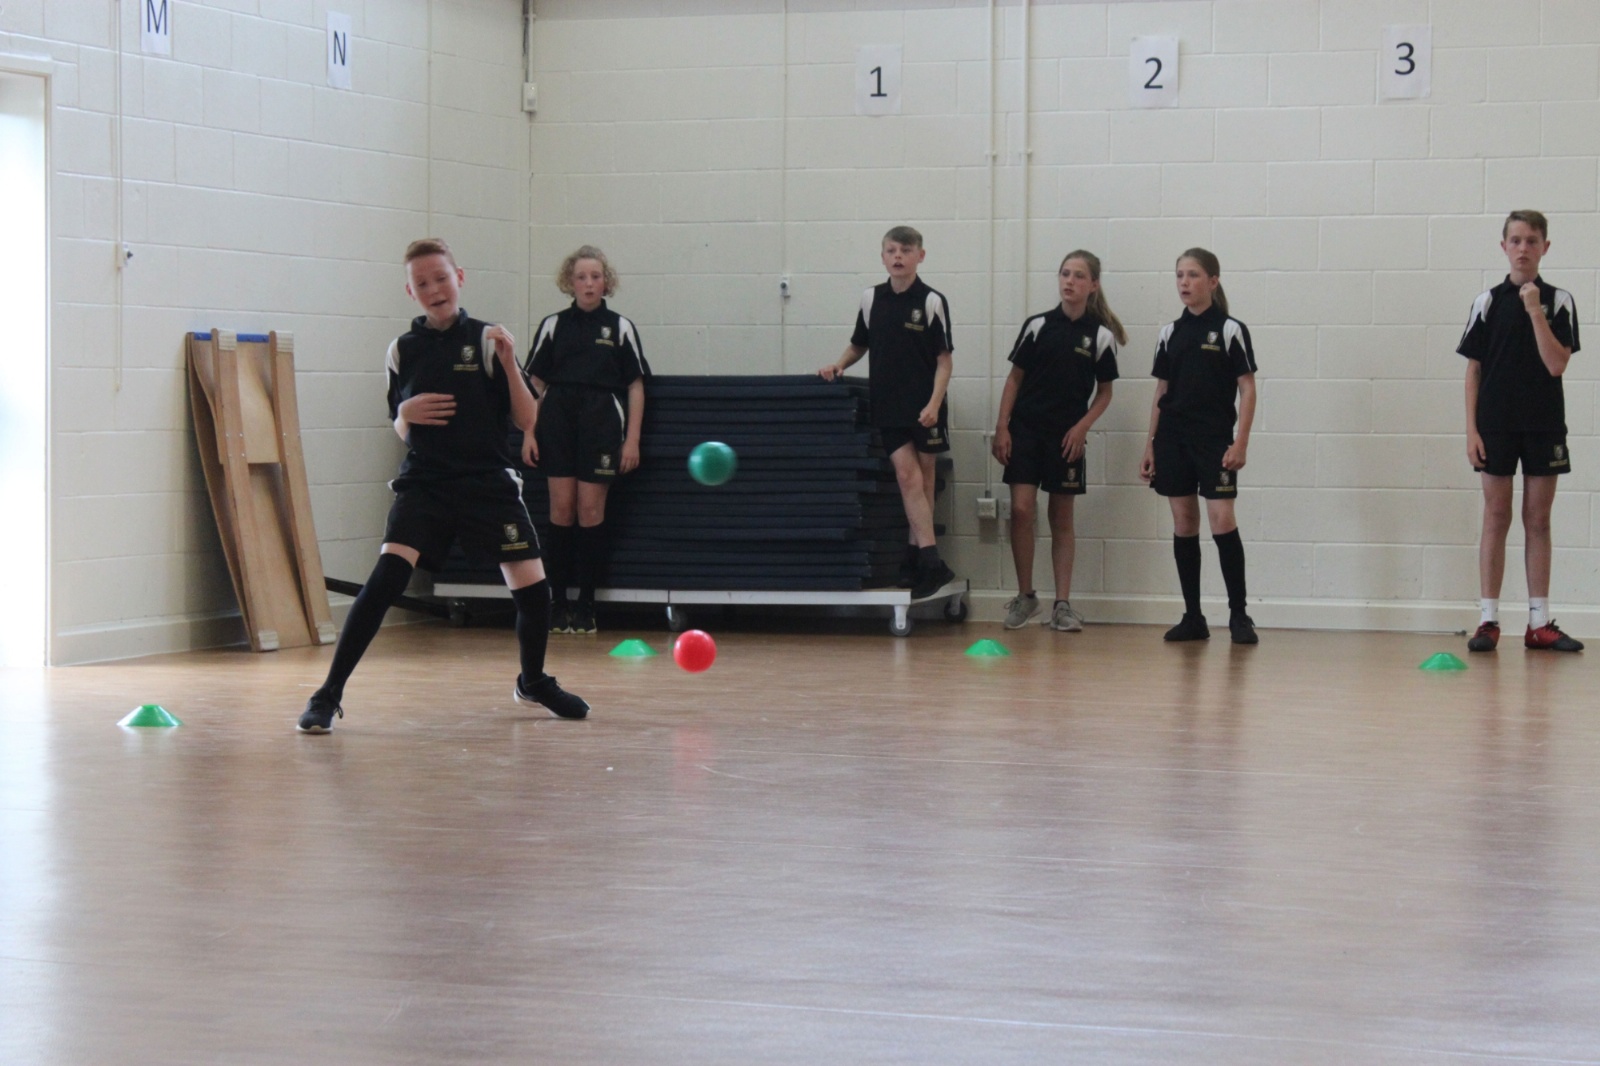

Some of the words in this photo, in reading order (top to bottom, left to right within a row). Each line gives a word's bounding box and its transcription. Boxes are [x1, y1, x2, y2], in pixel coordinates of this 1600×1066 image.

[147, 0, 167, 35] M
[333, 30, 346, 66] N
[1394, 42, 1416, 76] 3
[870, 66, 888, 98] 1
[1143, 57, 1163, 89] 2
